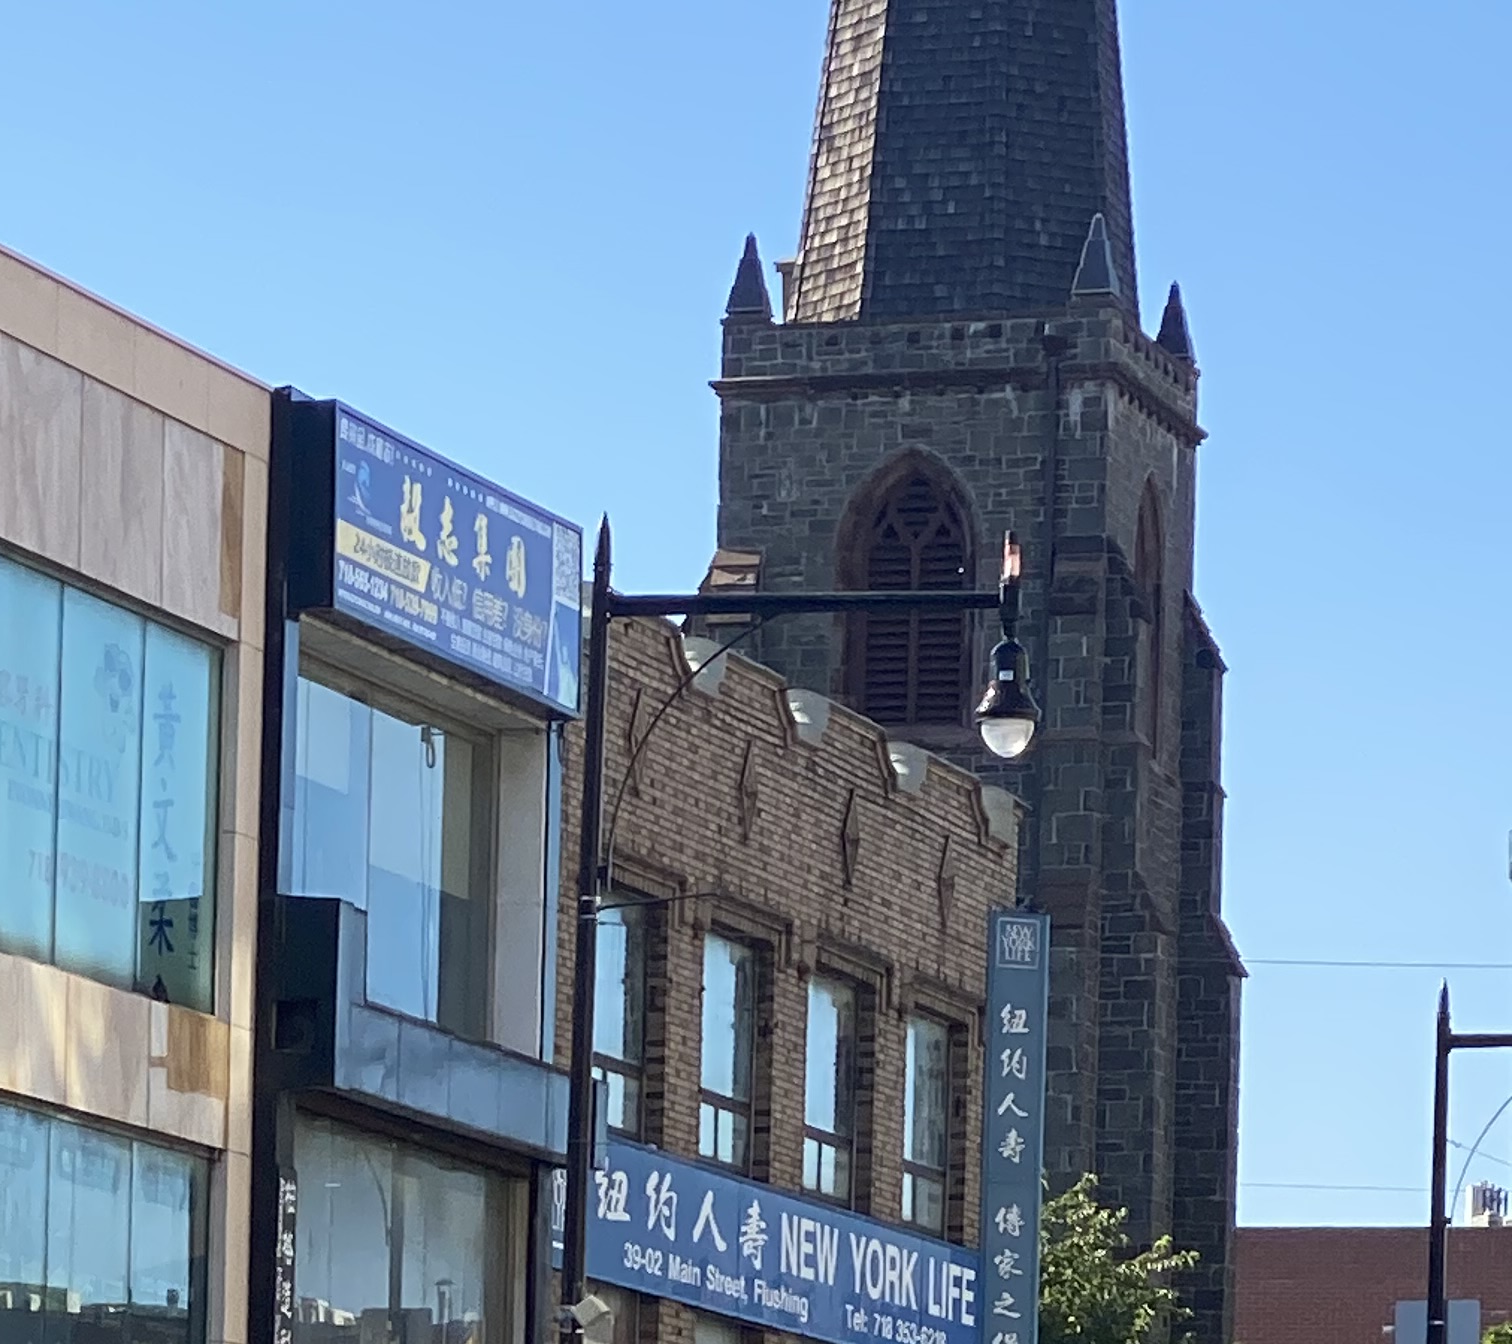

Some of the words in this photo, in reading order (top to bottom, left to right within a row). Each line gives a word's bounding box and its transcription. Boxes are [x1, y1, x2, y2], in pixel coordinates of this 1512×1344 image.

[1004, 922, 1033, 938] NEW
[1000, 935, 1037, 950] YORK
[1004, 947, 1032, 963] LIFE
[779, 1211, 839, 1287] NEW
[849, 1231, 919, 1311] YORK
[927, 1256, 977, 1328] LIFE
[623, 1241, 663, 1276] 39-02
[667, 1253, 702, 1288] Main
[705, 1263, 749, 1306] Street,
[753, 1278, 809, 1324] Flushing
[872, 1312, 894, 1341] 718
